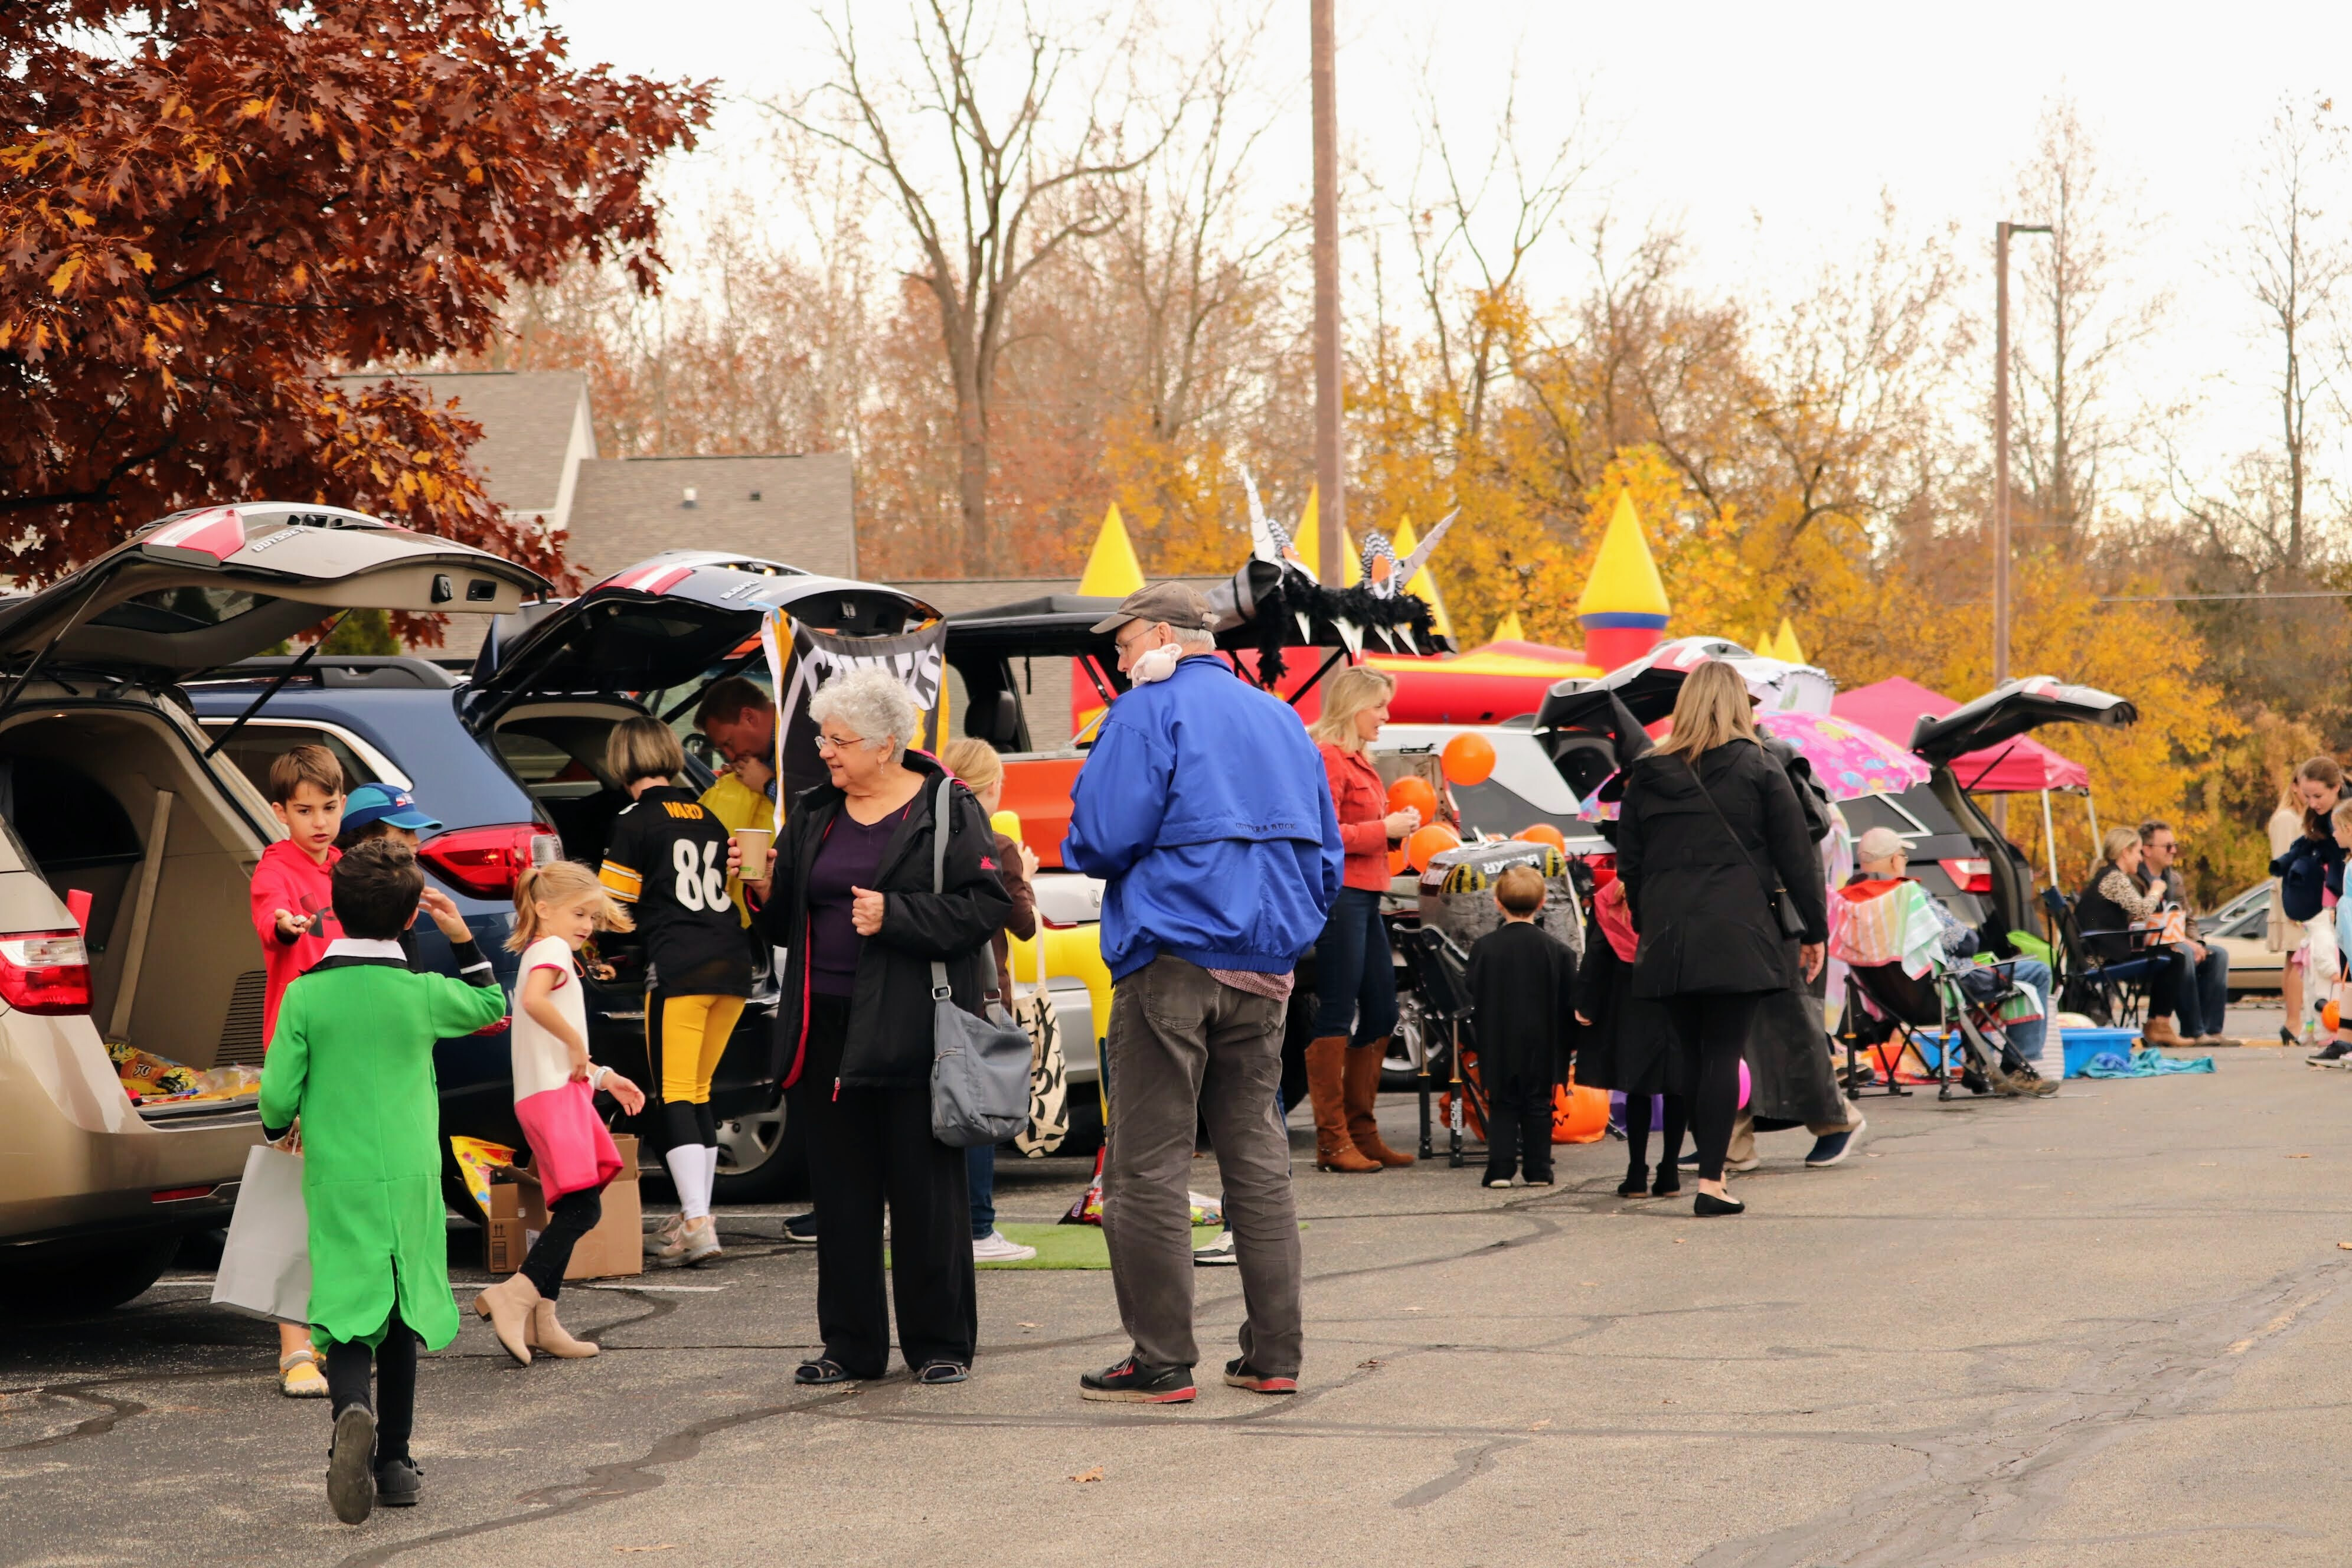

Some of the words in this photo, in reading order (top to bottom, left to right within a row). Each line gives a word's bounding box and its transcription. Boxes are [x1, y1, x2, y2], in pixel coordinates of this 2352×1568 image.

[251, 527, 305, 552] ODYSSEY
[720, 580, 760, 600] SUBARU
[661, 801, 704, 819] WARD
[673, 838, 731, 913] 86
